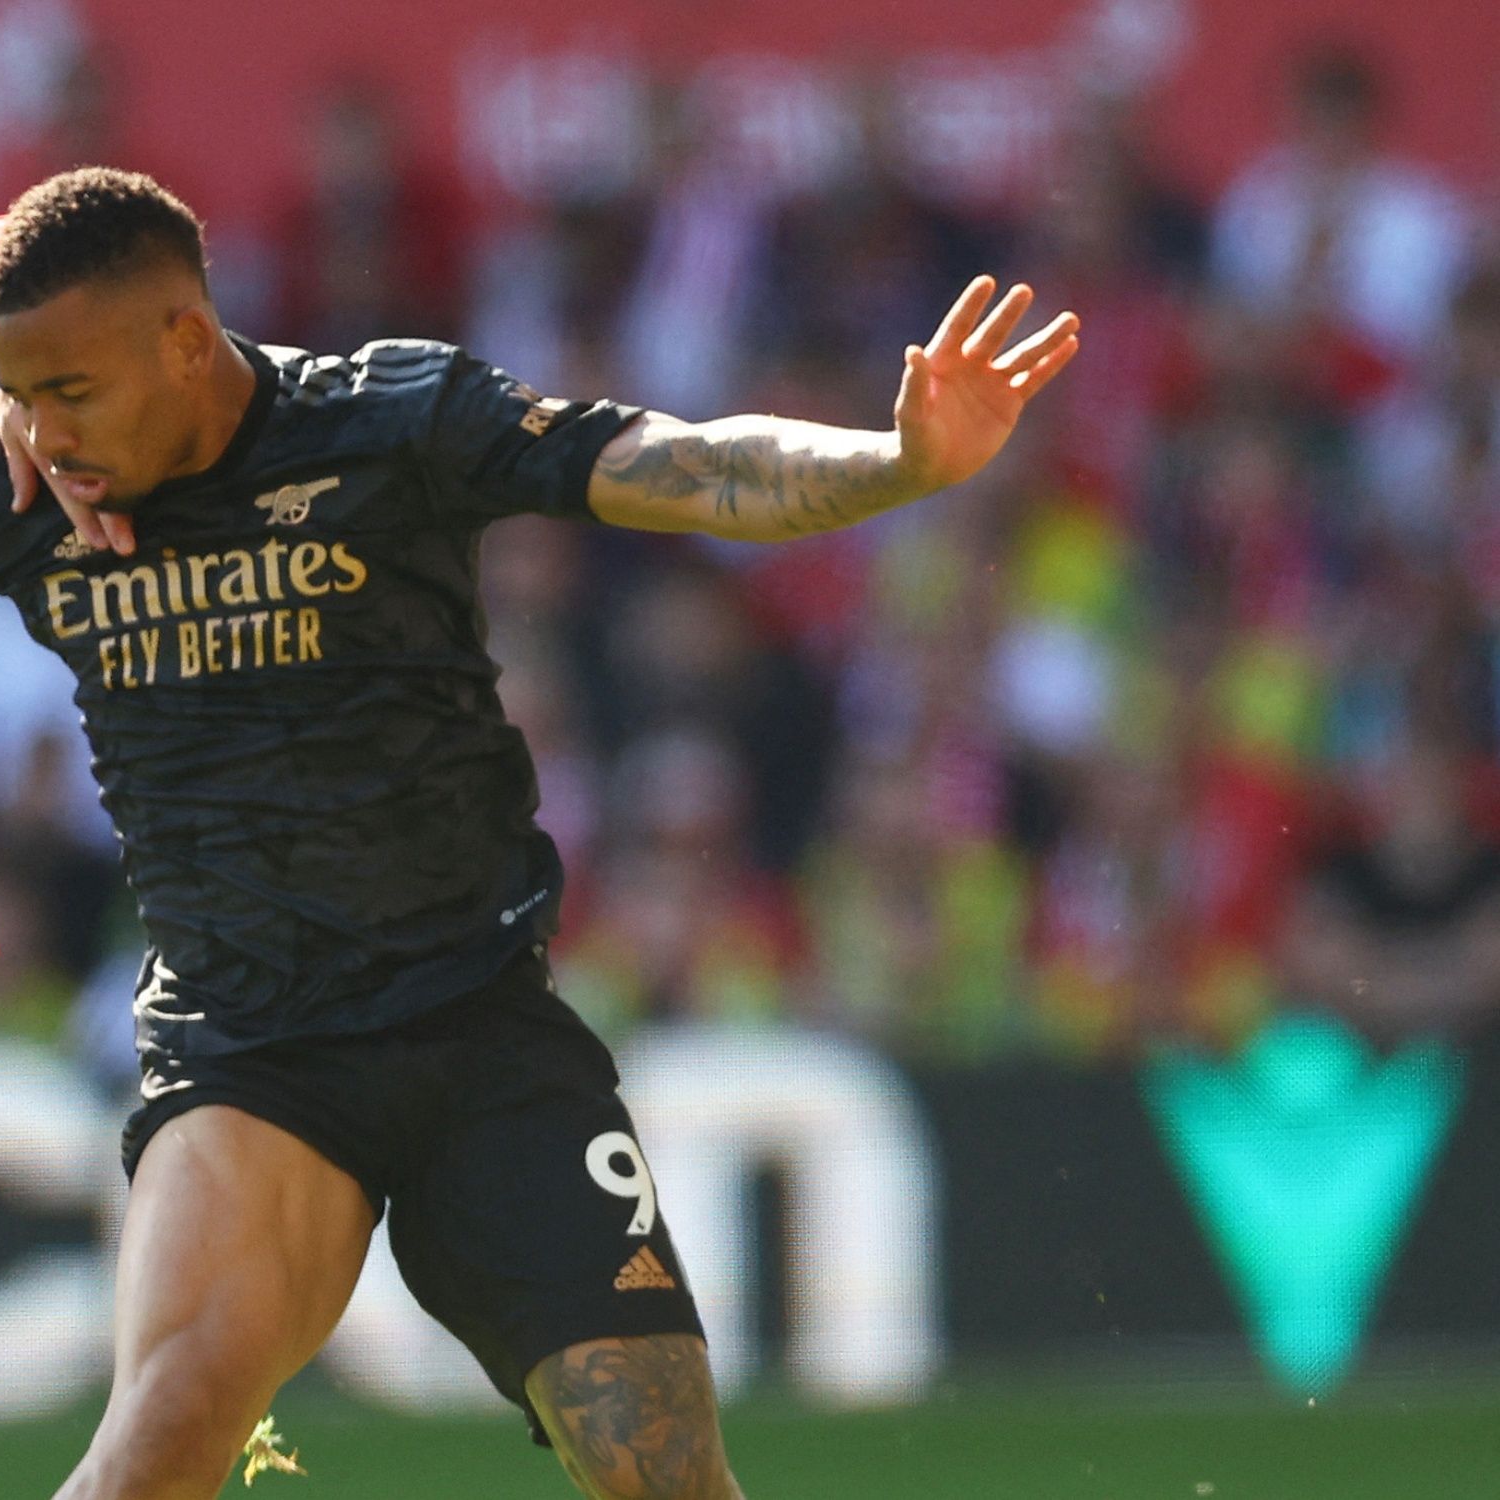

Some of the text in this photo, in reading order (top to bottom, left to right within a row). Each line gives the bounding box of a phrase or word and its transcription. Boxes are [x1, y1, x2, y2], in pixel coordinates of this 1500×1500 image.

[43, 536, 367, 640] Emirates
[100, 607, 323, 691] FLY BETTER
[585, 1130, 656, 1236] 9
